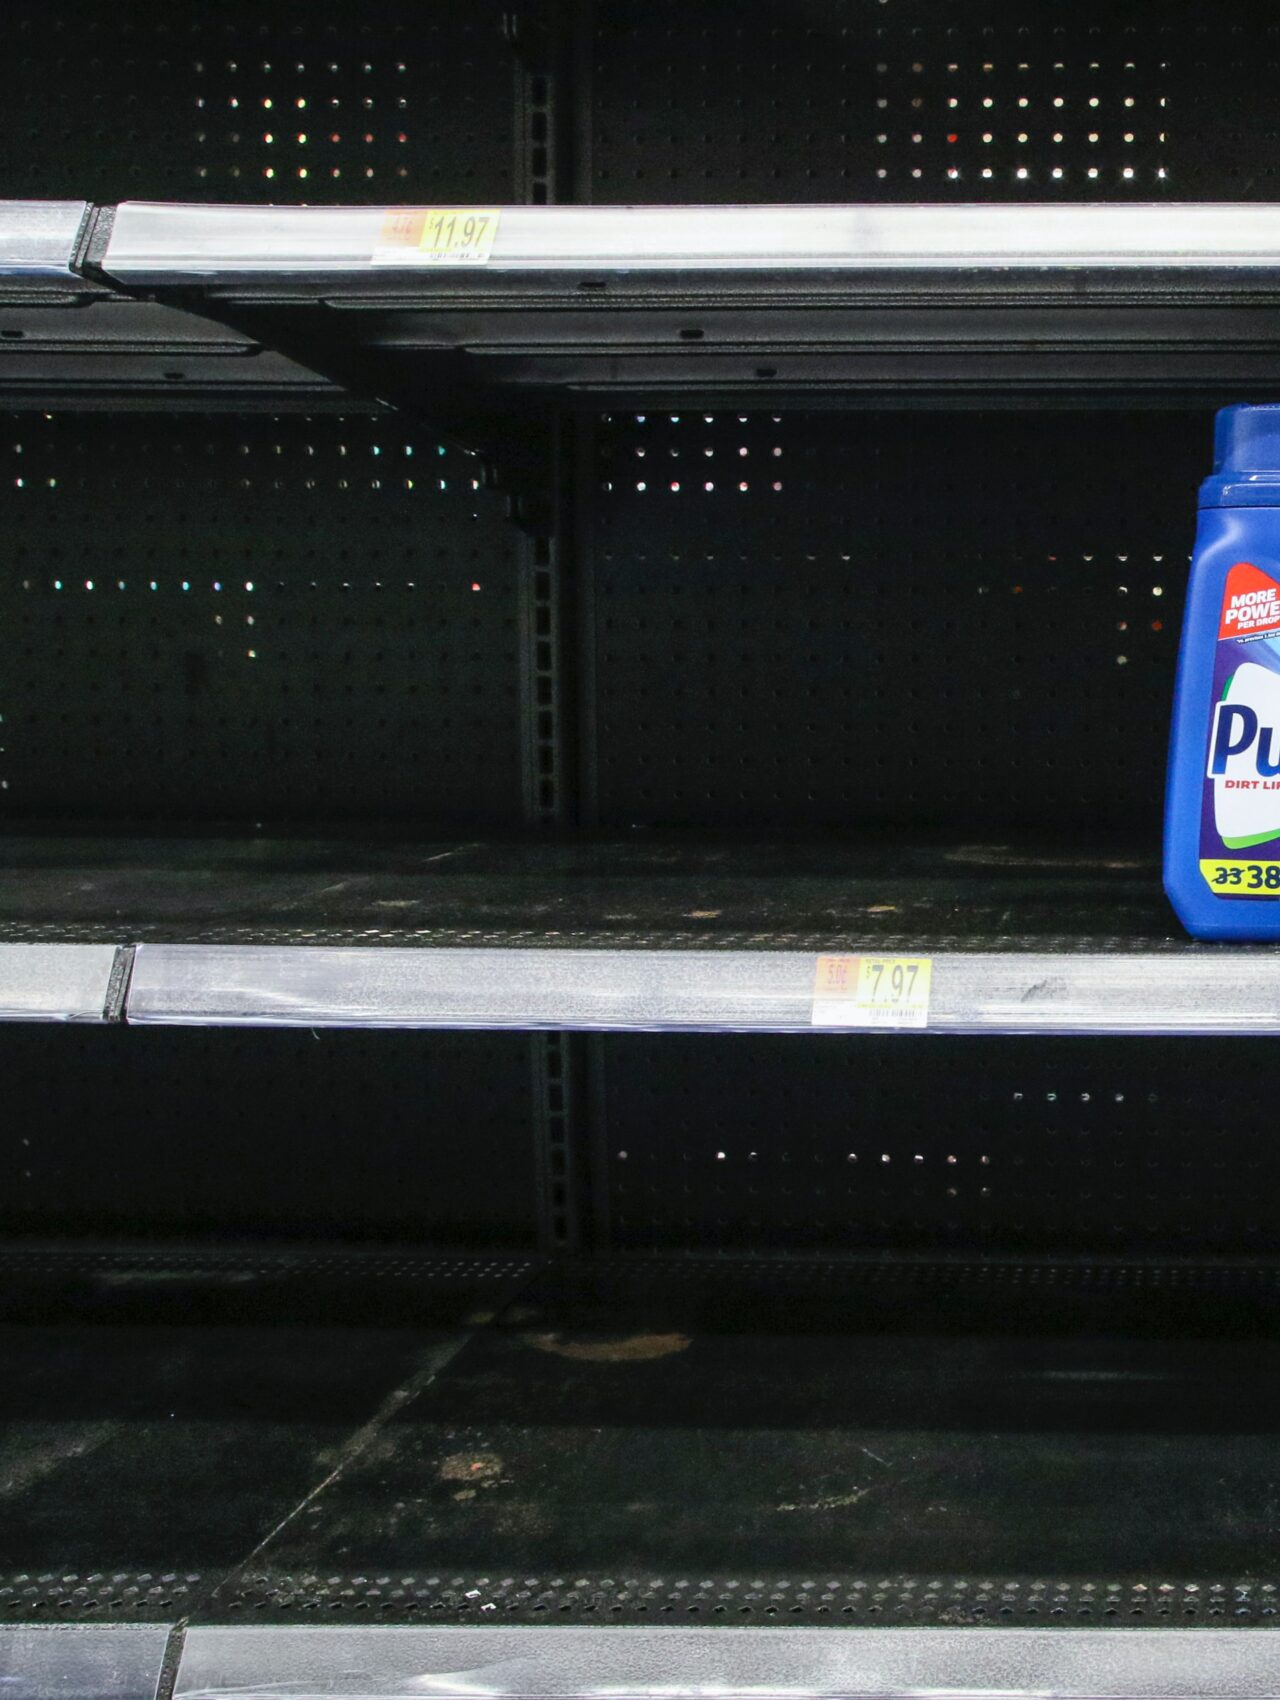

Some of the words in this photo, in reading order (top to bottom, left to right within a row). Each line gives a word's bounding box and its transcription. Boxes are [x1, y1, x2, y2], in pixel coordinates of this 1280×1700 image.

[428, 214, 490, 249] $11.97
[1231, 588, 1277, 609] MORE
[1237, 620, 1255, 630] PER
[1225, 780, 1260, 789] DIRT
[865, 964, 919, 1003] $7.97
